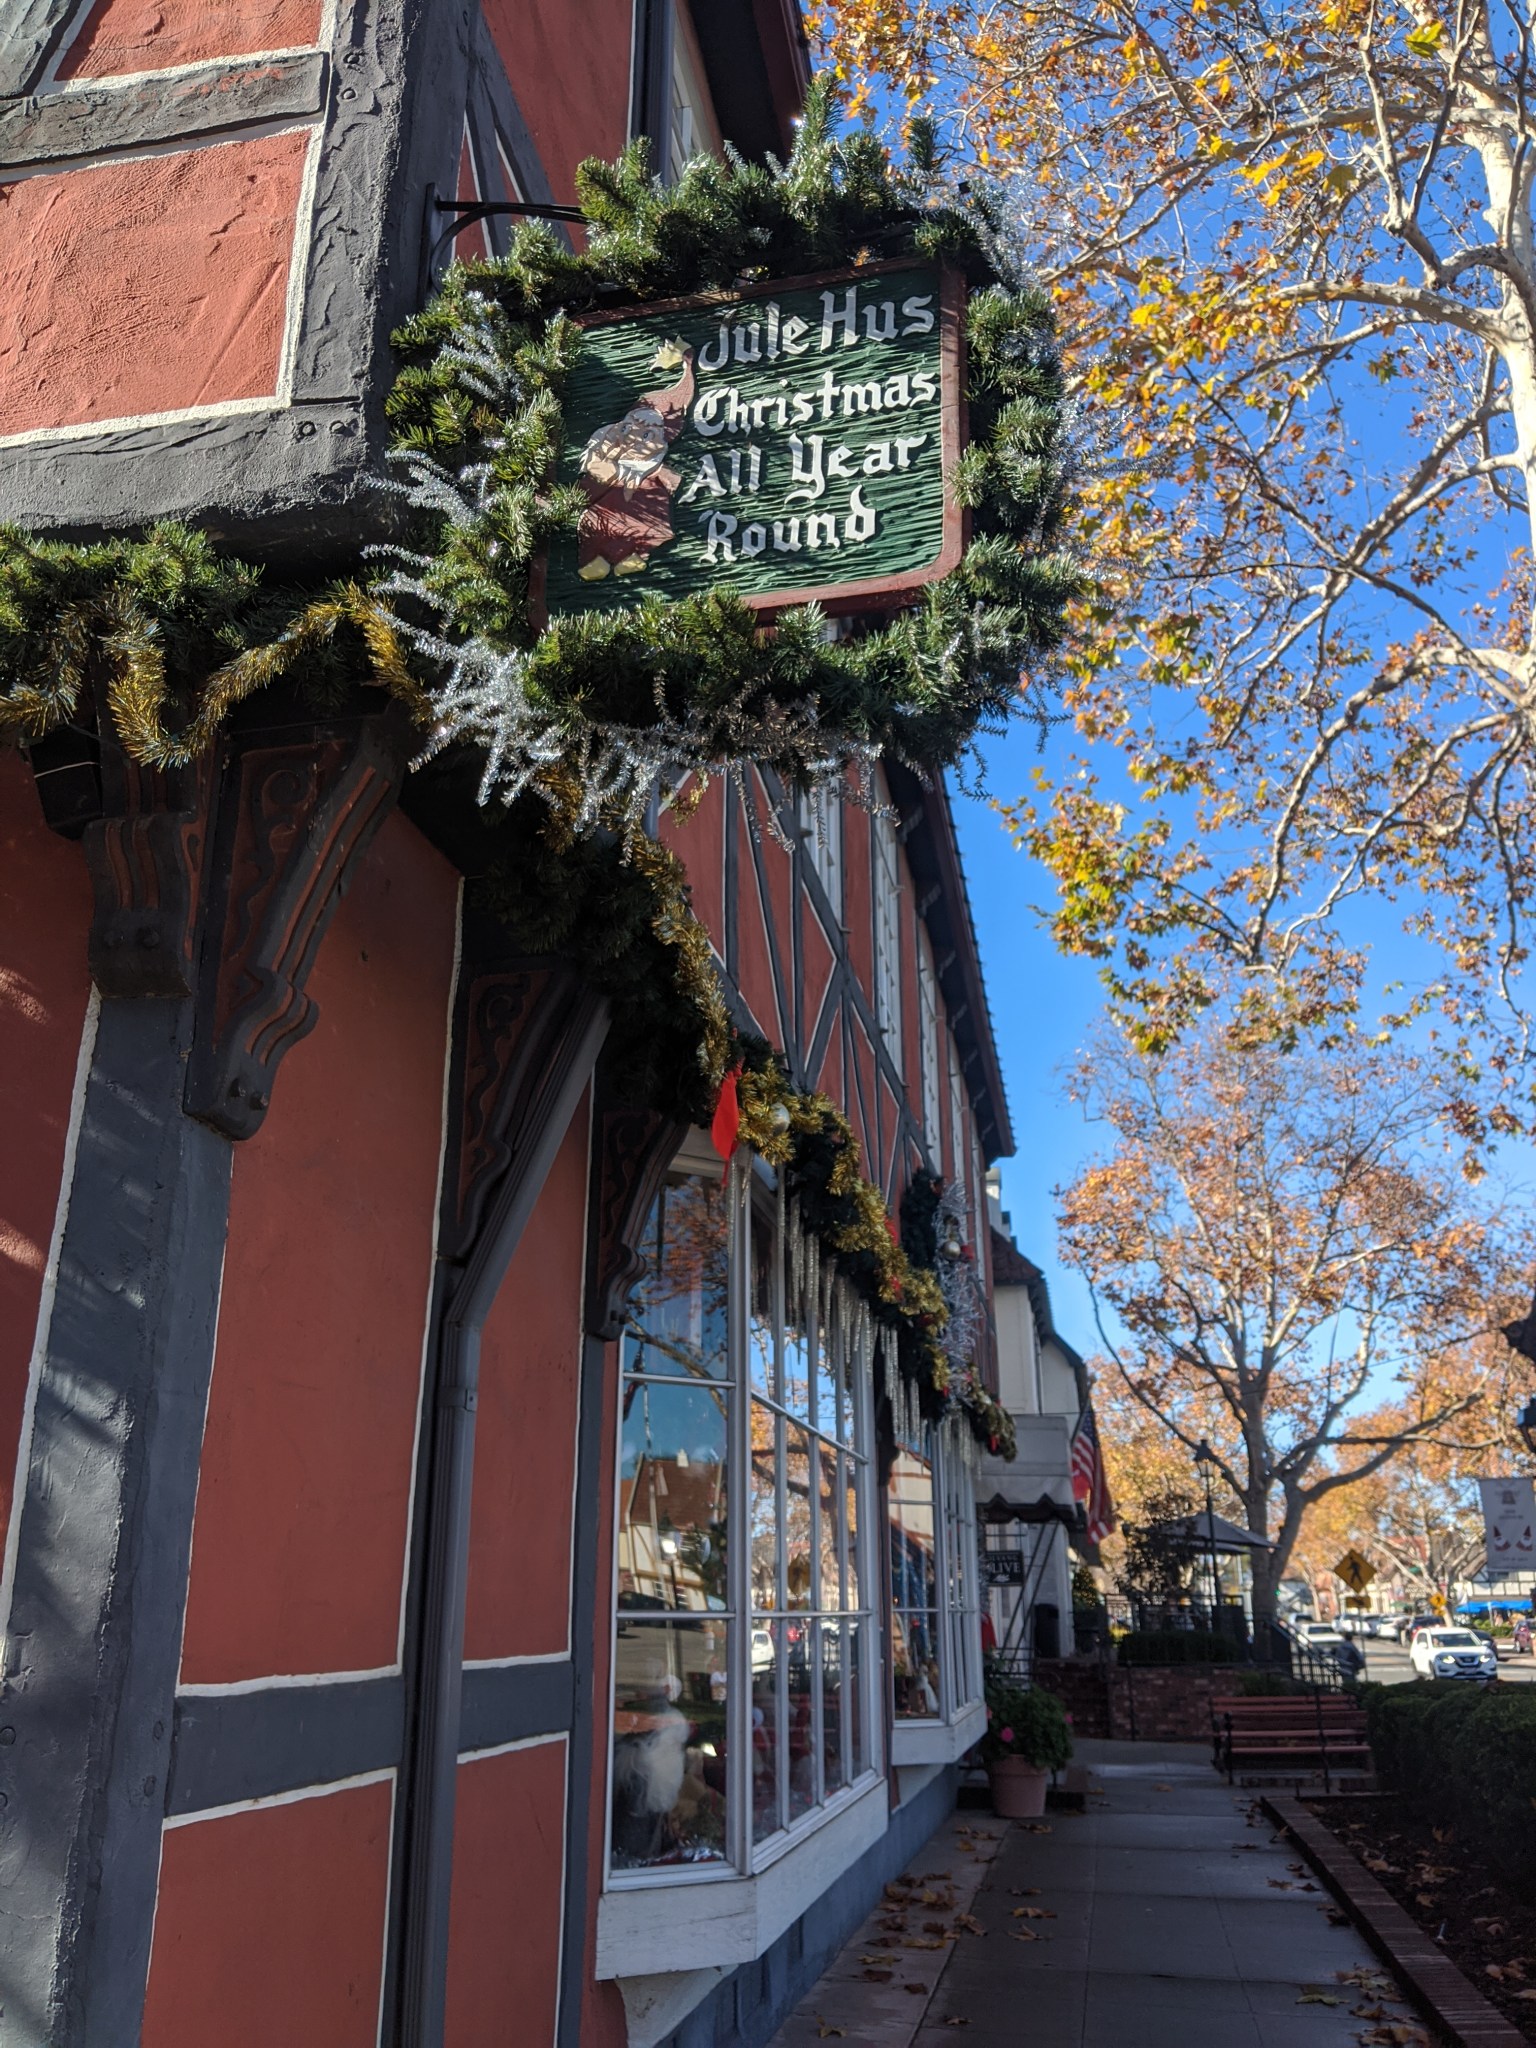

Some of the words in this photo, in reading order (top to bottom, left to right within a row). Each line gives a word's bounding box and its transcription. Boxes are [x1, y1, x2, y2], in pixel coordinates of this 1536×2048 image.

[698, 301, 809, 371] Jule
[820, 286, 934, 354] Hus
[694, 371, 937, 438] Christmas
[678, 445, 762, 504] All
[784, 433, 928, 506] Year
[698, 485, 876, 564] Round
[990, 1562, 1021, 1573] LIVE
